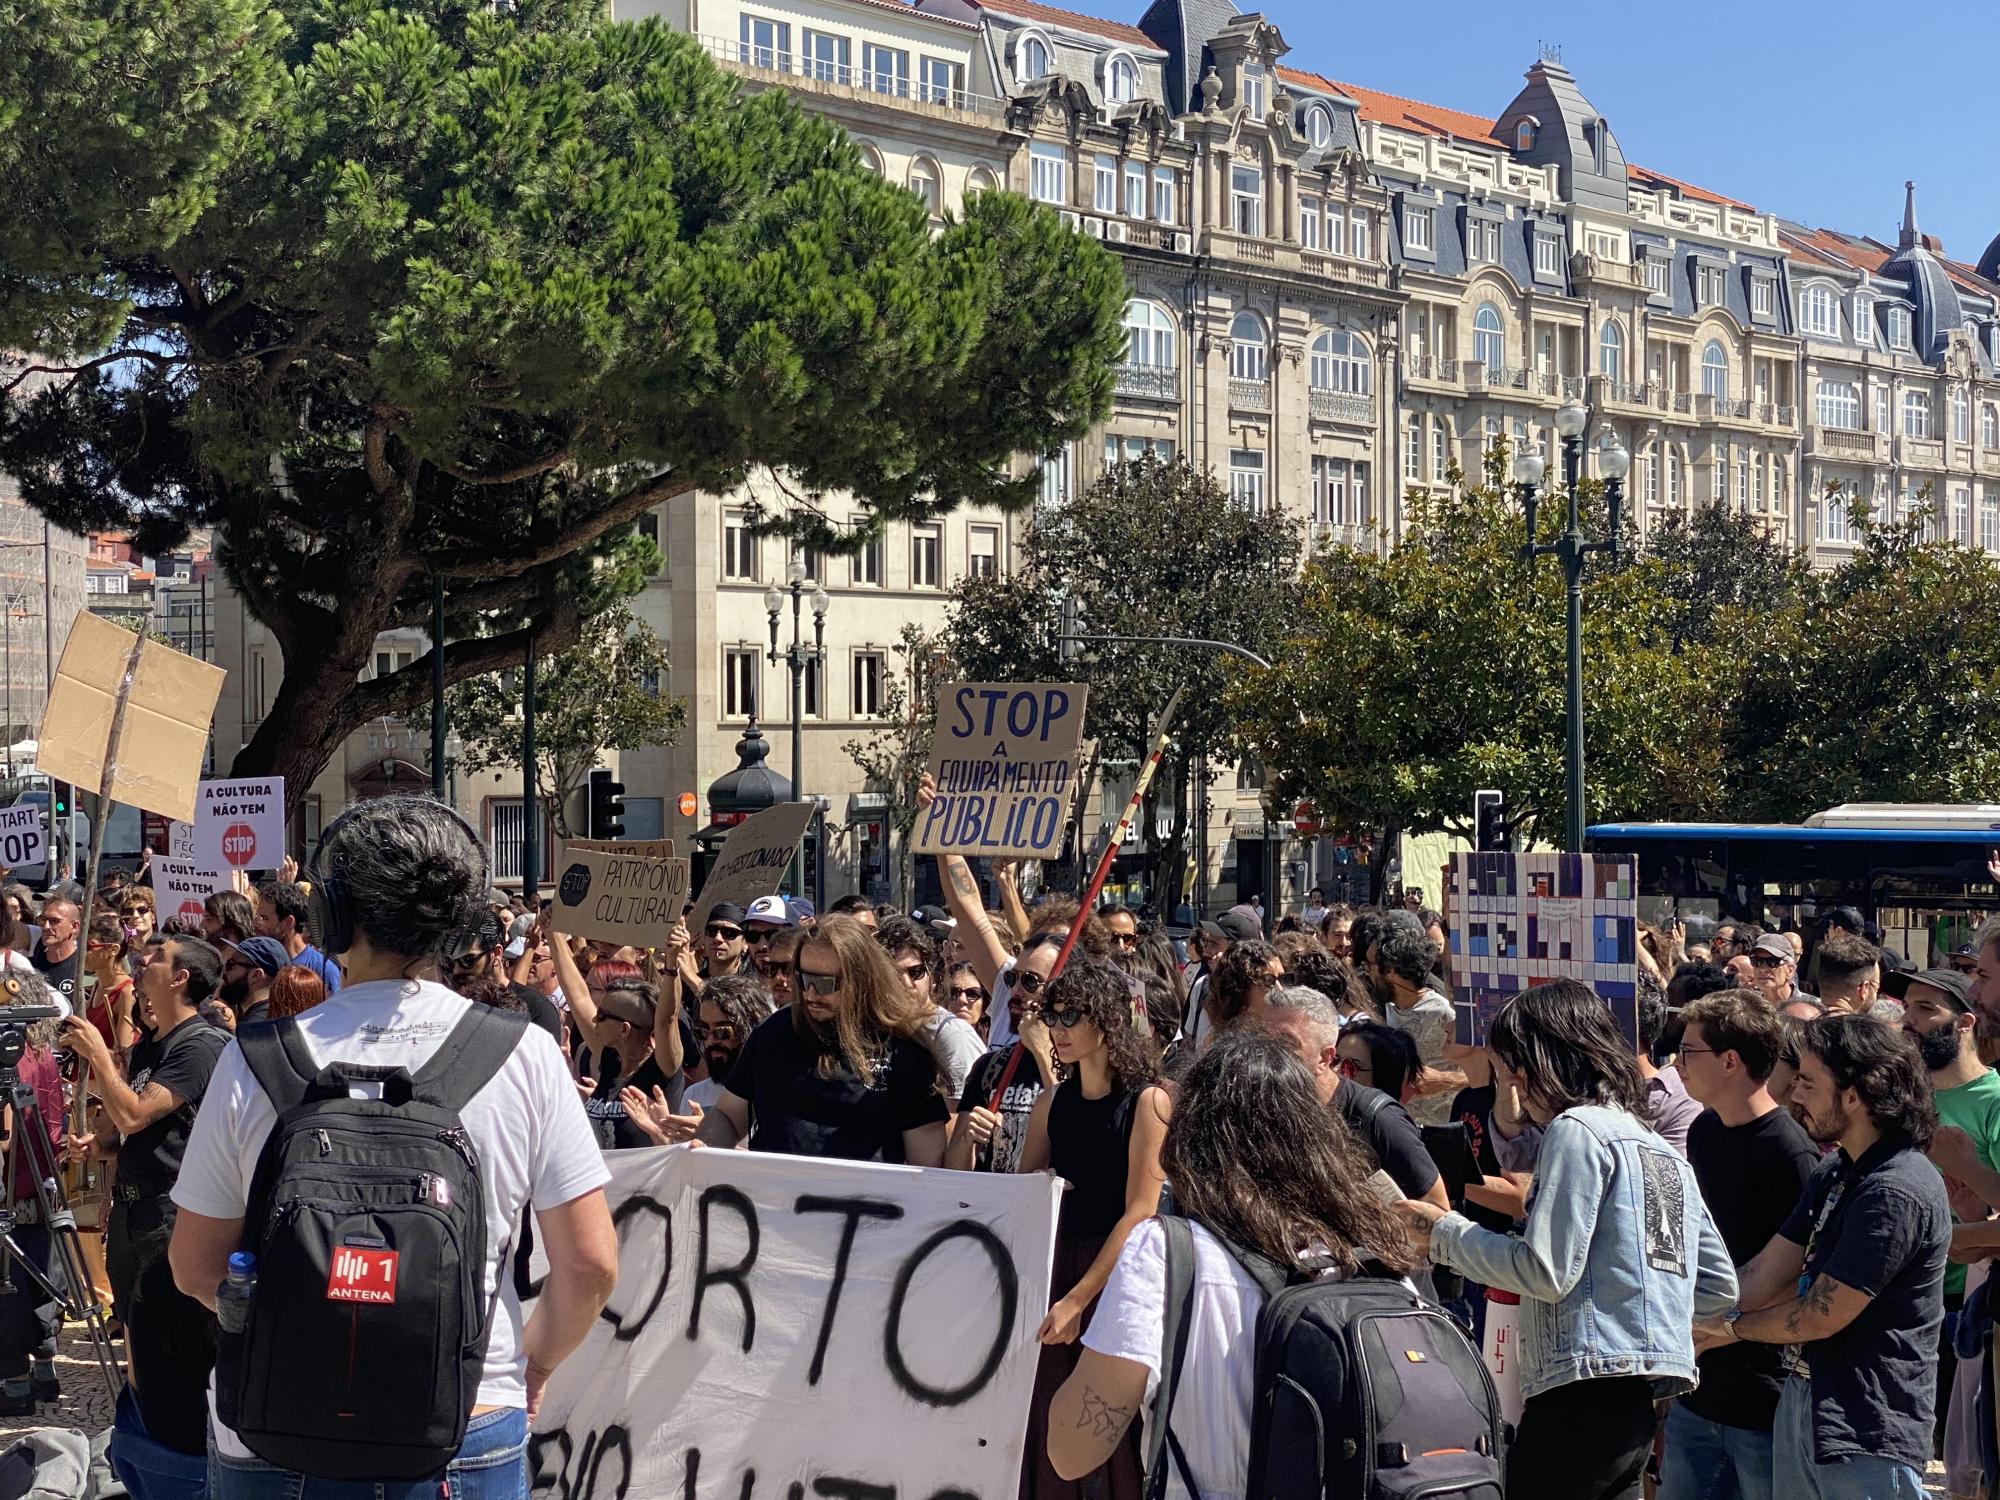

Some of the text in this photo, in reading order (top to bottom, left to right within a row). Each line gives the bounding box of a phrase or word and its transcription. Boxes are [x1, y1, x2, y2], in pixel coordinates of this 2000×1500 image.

[951, 687, 1069, 741] STOP
[936, 759, 1068, 795] EQUIPAMENTO
[205, 785, 272, 798] A CULTURA
[0, 809, 34, 828] TART
[213, 803, 265, 816] NÃO TEM
[224, 836, 254, 853] STOP
[162, 864, 168, 873] A
[168, 880, 214, 894] NÃO TEM
[563, 872, 590, 892] STOP
[180, 911, 203, 925] STO
[595, 894, 676, 925] CULTURAL
[379, 1259, 393, 1282] 1
[330, 1287, 392, 1301] ANTENA
[514, 1183, 1019, 1408] ORTO
